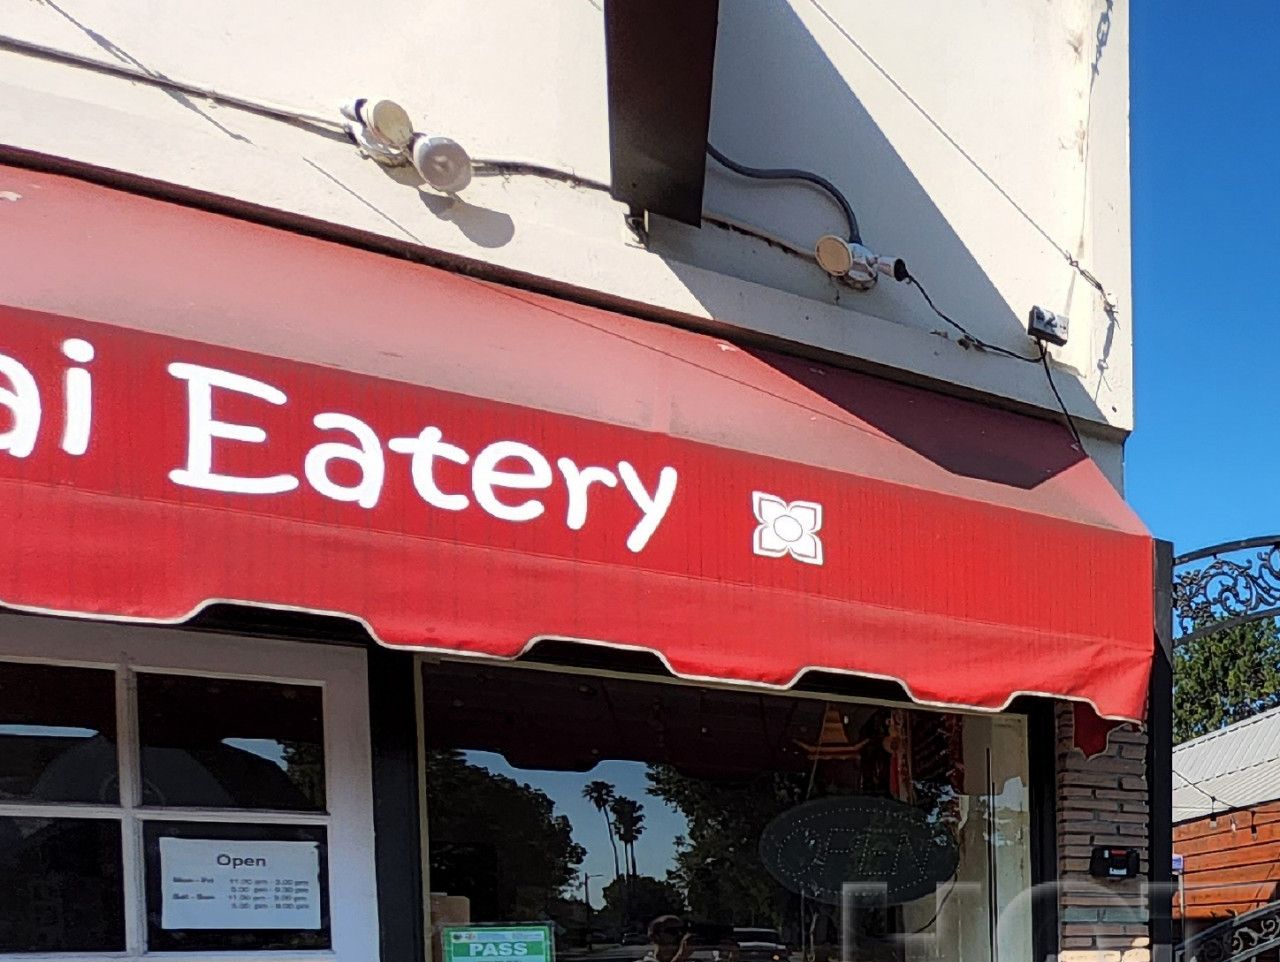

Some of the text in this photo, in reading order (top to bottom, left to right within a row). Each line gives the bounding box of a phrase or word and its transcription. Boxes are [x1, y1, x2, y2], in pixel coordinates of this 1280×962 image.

[167, 361, 679, 554] Eatery
[216, 853, 267, 869] Open
[468, 942, 528, 957] PASS
